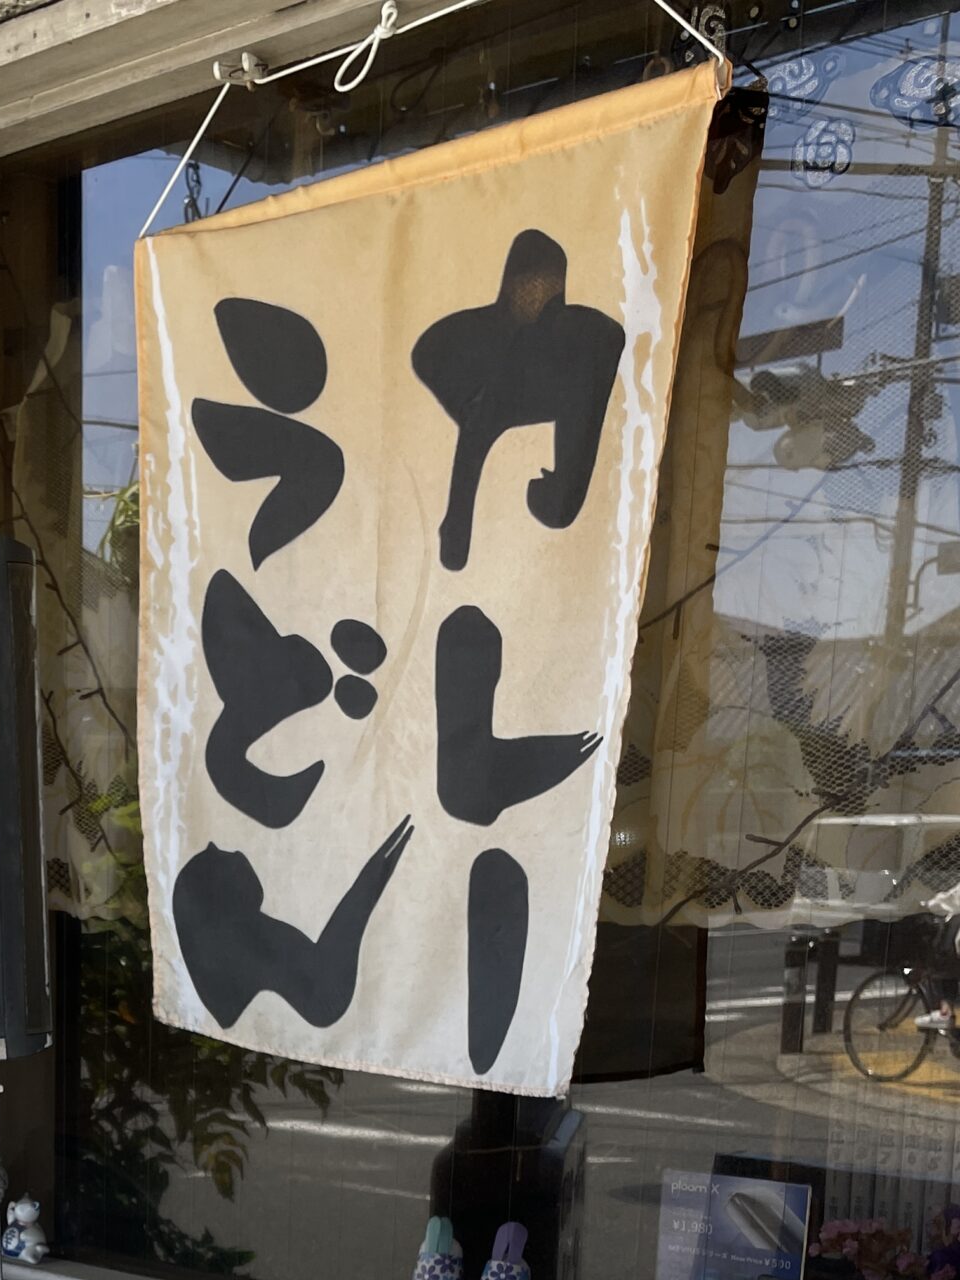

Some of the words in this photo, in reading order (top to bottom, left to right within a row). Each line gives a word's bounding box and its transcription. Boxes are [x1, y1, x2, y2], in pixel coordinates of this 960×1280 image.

[171, 296, 415, 1030] うどん
[411, 228, 626, 1075] カレー
[711, 1183, 720, 1194] X
